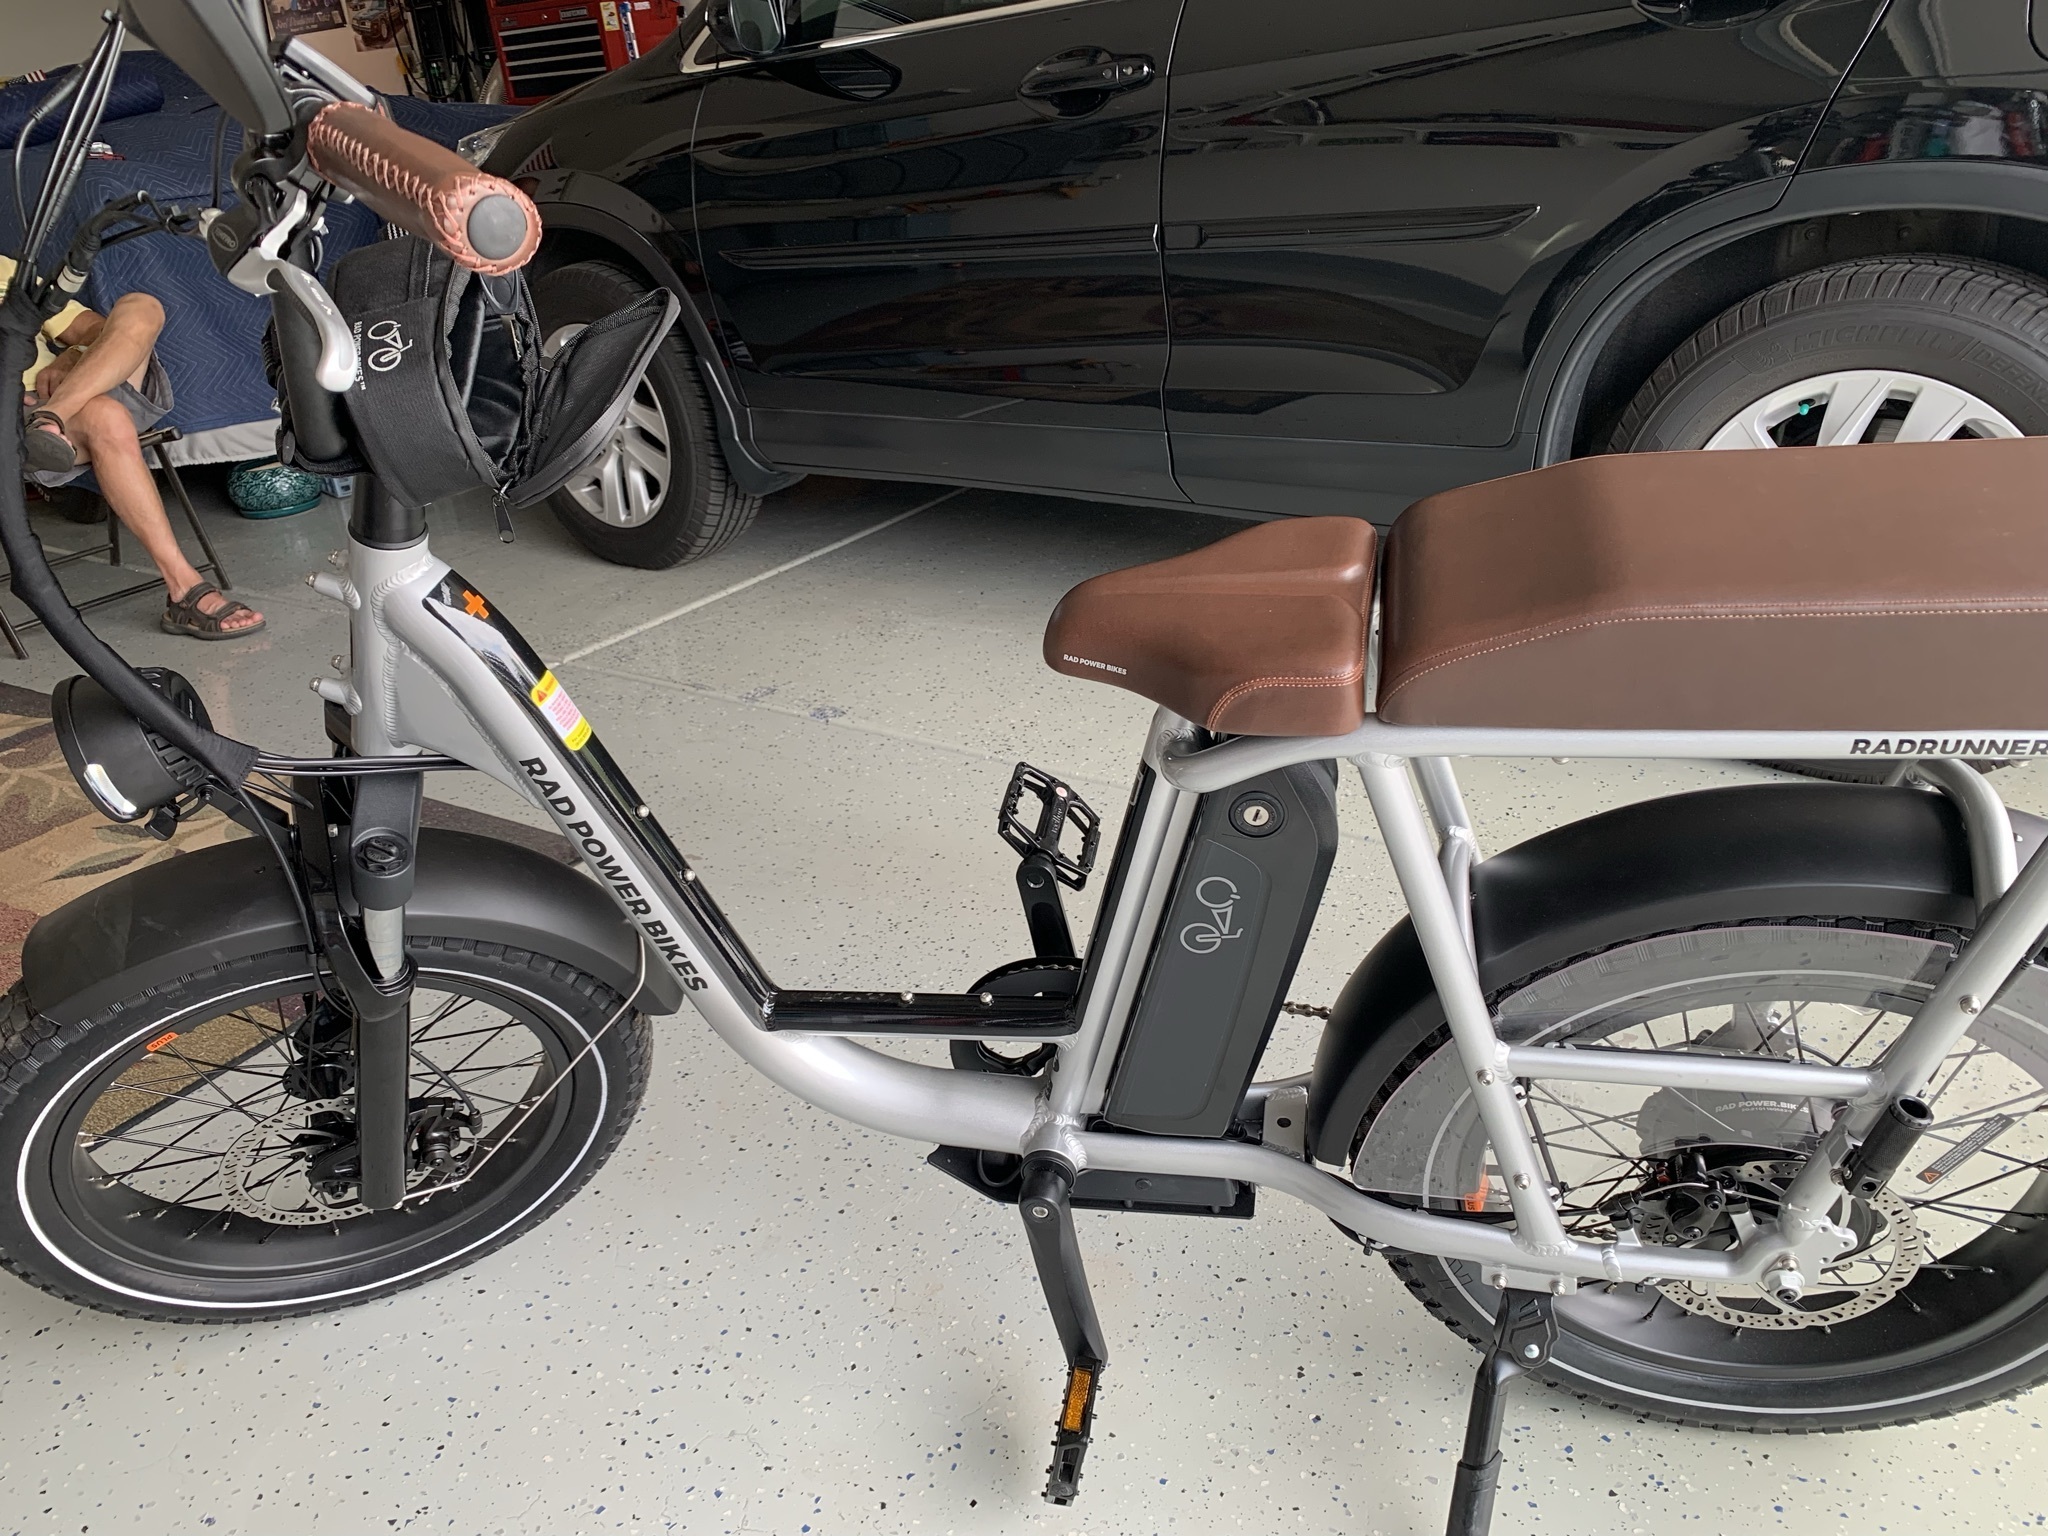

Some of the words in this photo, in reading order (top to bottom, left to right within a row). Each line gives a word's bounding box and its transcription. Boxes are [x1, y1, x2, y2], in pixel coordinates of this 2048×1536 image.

[353, 320, 363, 334] RAD
[1795, 324, 1956, 351] MICHELIN
[1973, 347, 2048, 403] DEFEN
[1063, 654, 1079, 663] RAD
[1079, 657, 1106, 670] POWER
[1106, 664, 1127, 675] BIKES
[1849, 738, 2048, 755] RADRUNNER
[518, 756, 577, 817] RAD
[566, 820, 653, 919] POWER
[642, 919, 709, 992] BIKES
[150, 1034, 173, 1049] PLUS
[1715, 1103, 1736, 1112] RAD
